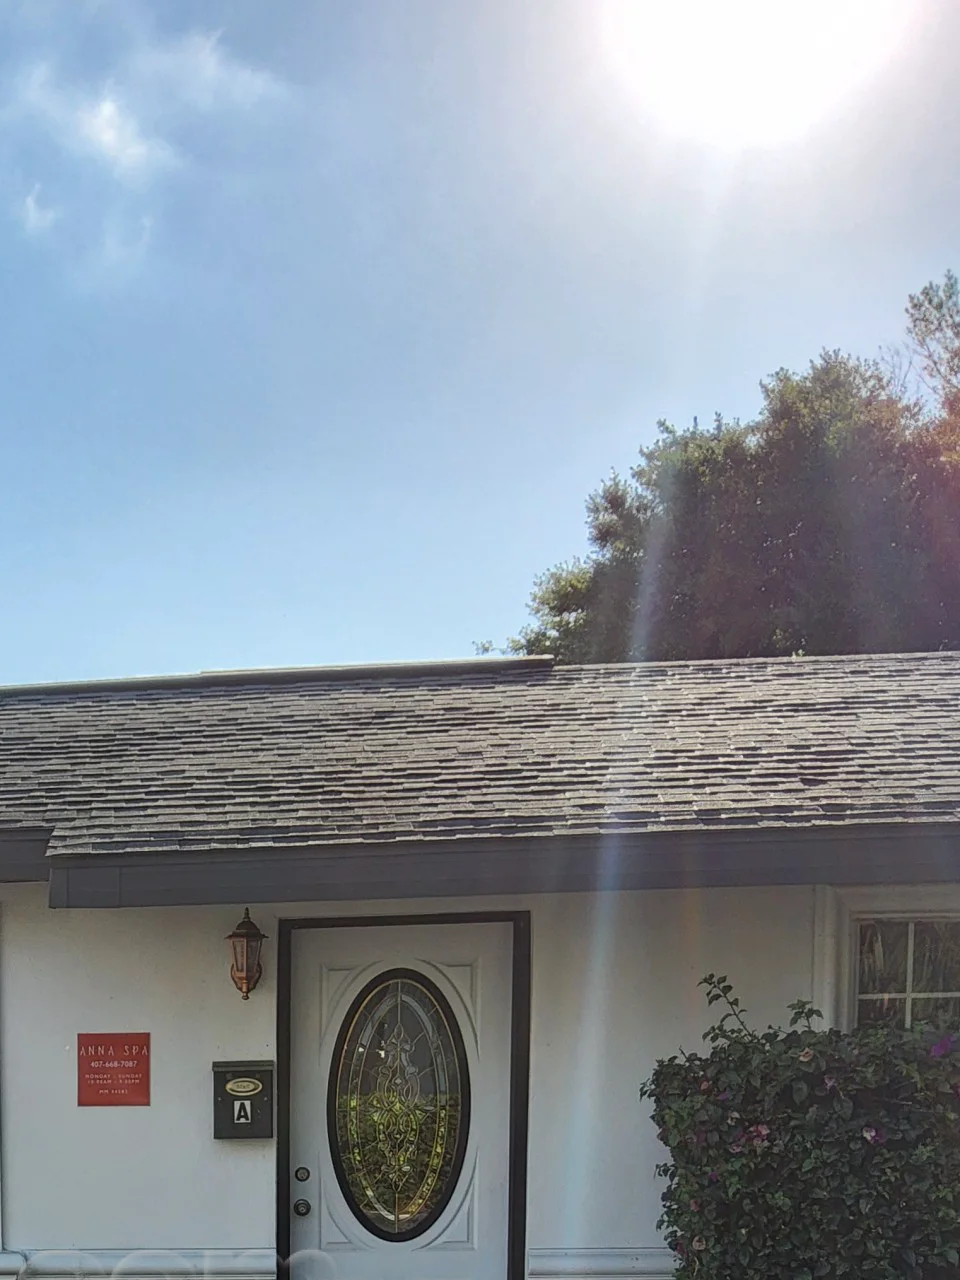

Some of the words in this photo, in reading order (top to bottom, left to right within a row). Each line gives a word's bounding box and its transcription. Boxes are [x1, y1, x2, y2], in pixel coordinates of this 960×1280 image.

[79, 1045, 115, 1056] ANNA
[123, 1045, 148, 1056] SPA
[236, 1102, 250, 1121] A
